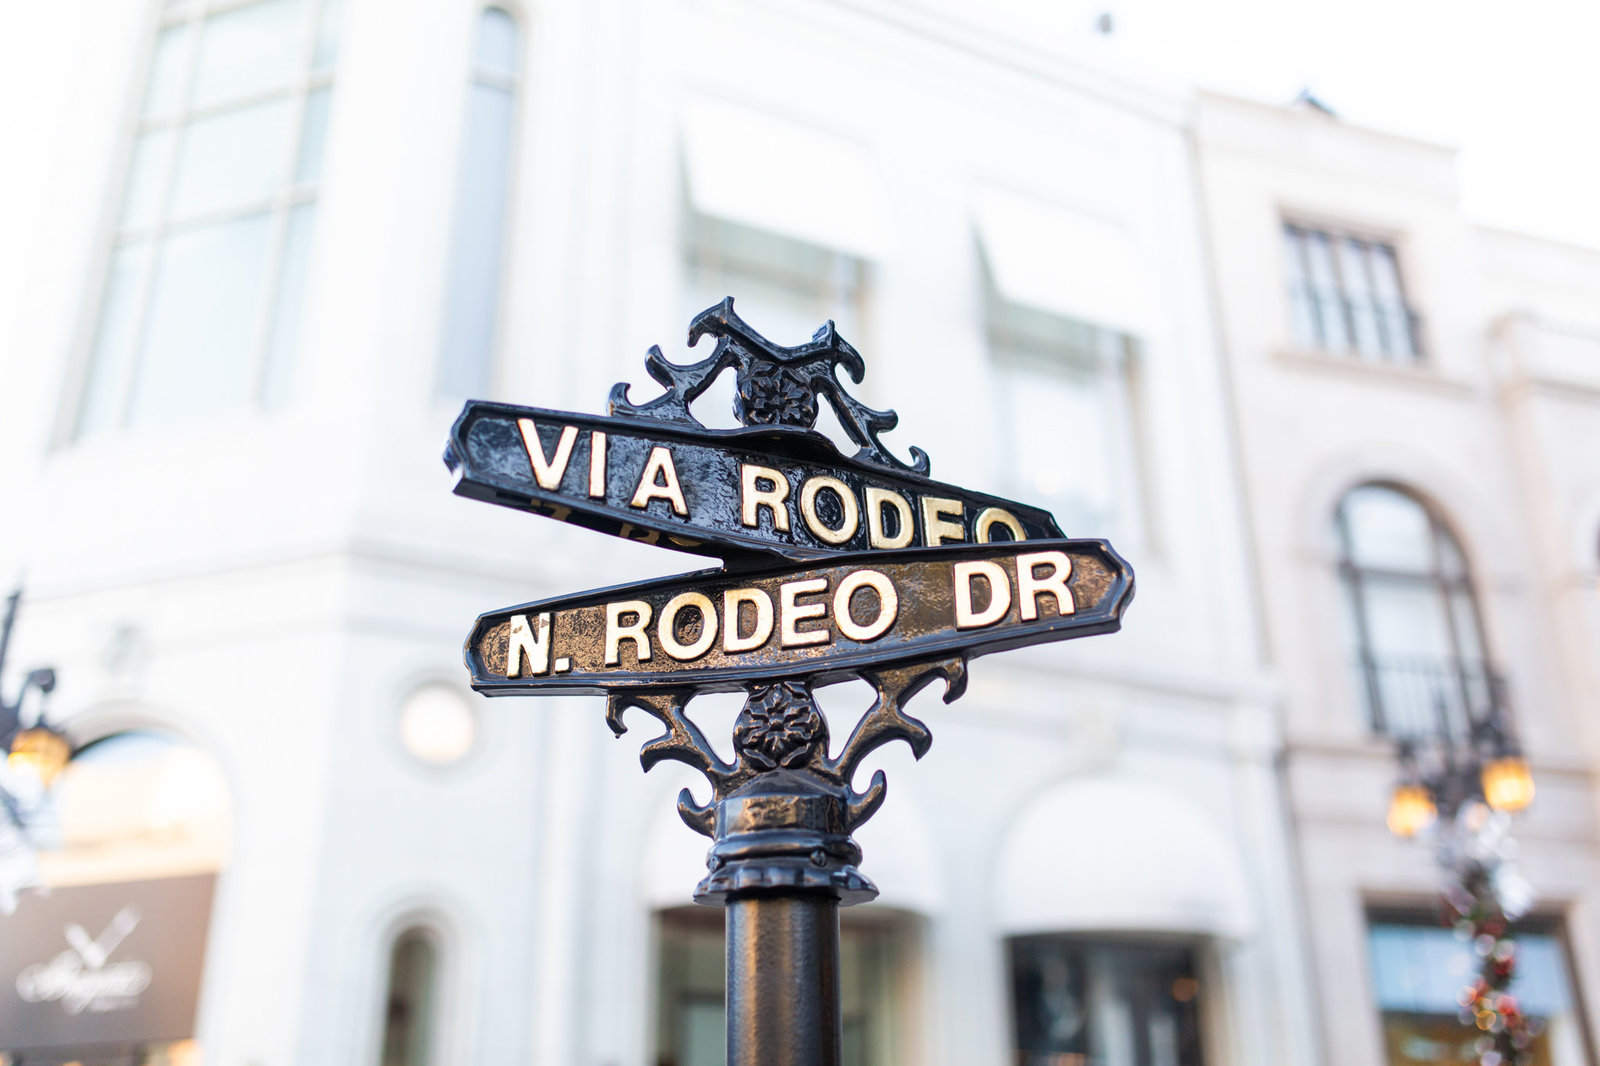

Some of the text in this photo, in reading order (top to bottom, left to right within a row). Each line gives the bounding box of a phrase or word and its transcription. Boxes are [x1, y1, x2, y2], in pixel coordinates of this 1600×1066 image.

[517, 418, 689, 516] VIA
[506, 550, 1075, 678] N. RODEO DR
